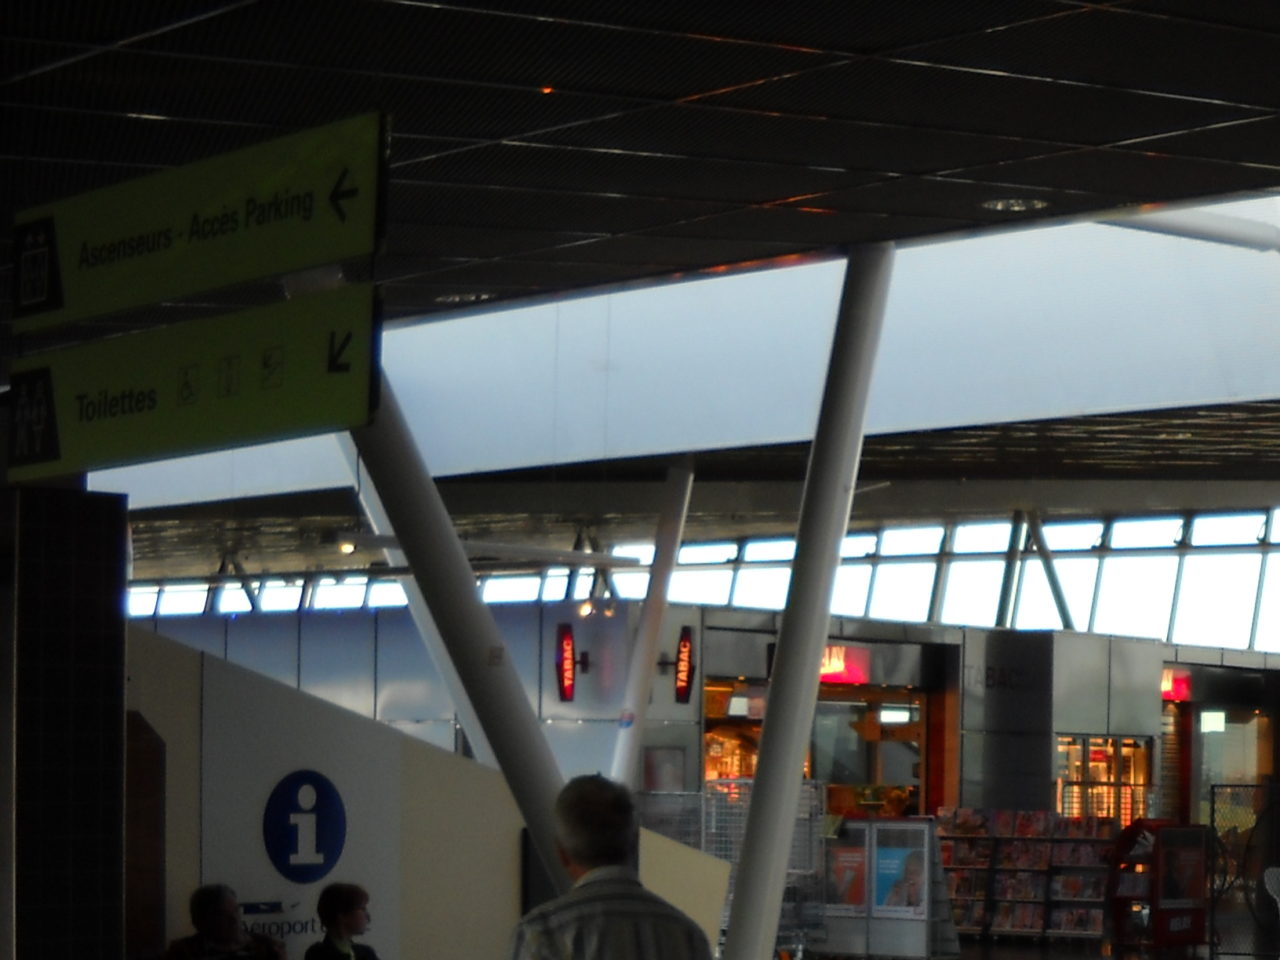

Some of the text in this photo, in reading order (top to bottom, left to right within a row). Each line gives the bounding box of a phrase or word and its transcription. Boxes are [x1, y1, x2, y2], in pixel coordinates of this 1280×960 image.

[78, 227, 173, 271] Ascenseurs
[187, 206, 240, 243] Accès
[245, 189, 314, 227] Parking
[76, 388, 157, 423] Toilettes
[563, 639, 573, 687] TABAC
[676, 641, 690, 687] TABAC
